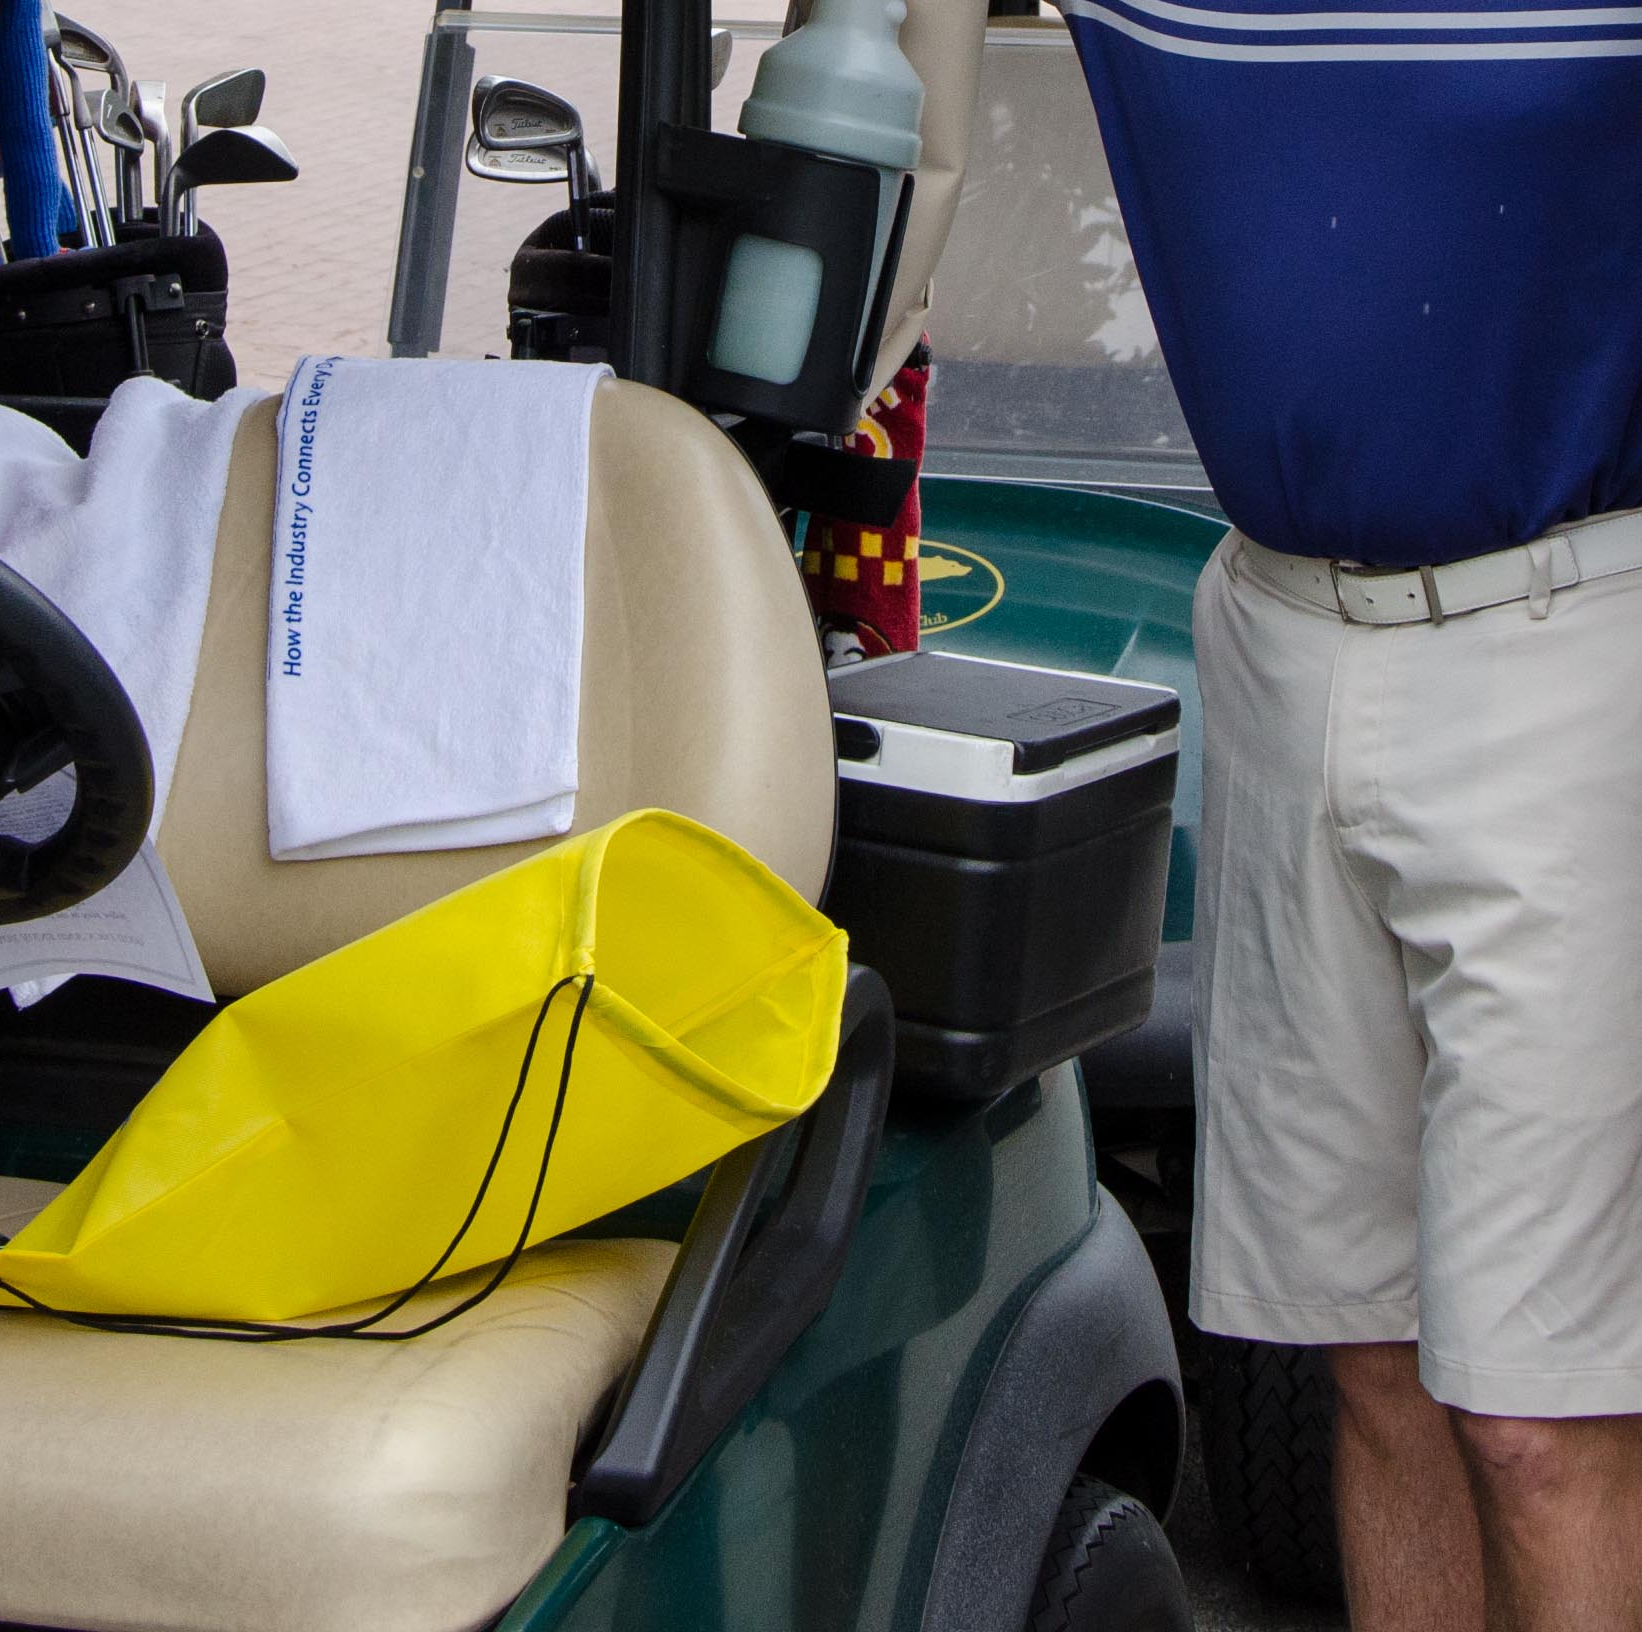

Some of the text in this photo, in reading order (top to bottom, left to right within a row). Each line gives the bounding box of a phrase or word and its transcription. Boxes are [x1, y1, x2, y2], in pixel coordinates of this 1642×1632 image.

[292, 410, 318, 497] Connects
[285, 501, 313, 585] Industry
[286, 591, 302, 624] the
[920, 612, 948, 626] lub
[283, 630, 302, 677] How
